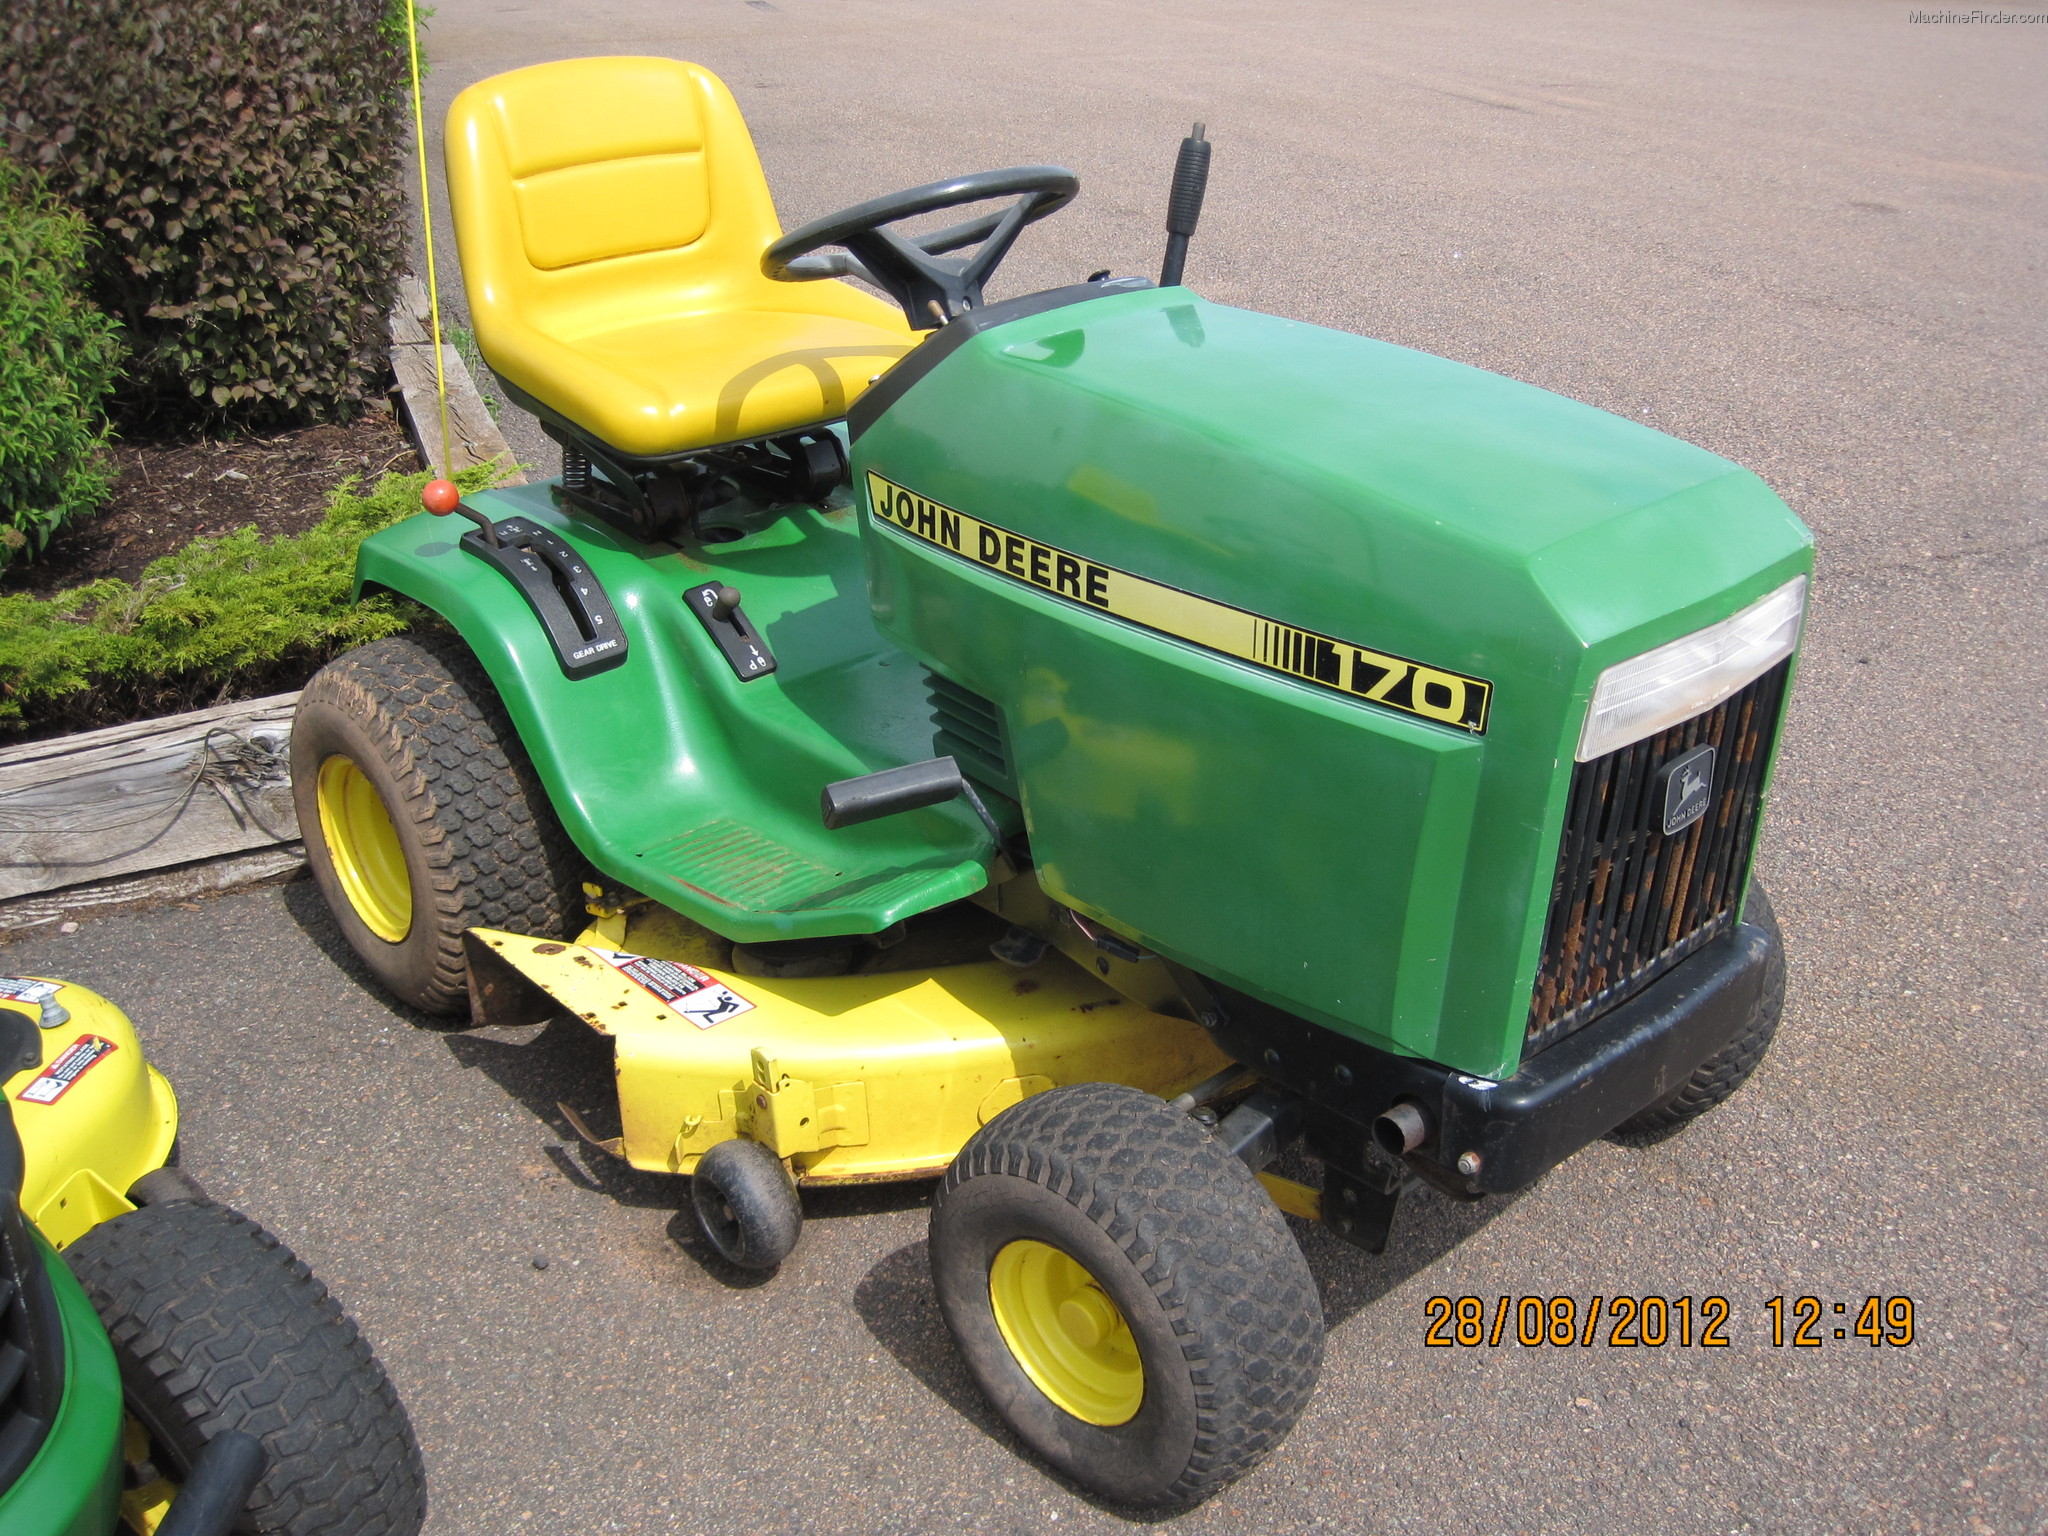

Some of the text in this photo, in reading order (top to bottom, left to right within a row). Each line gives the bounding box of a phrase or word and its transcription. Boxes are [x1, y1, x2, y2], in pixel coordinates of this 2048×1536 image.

[559, 550, 569, 558] 2
[879, 484, 1110, 609] JOHN DEERE
[572, 565, 582, 574] 3
[580, 587, 589, 596] 4
[594, 614, 604, 625] 5
[572, 639, 618, 660] GEAR DRIVE
[1329, 642, 1467, 725] 170
[1666, 797, 1707, 828] JOHN DEERE
